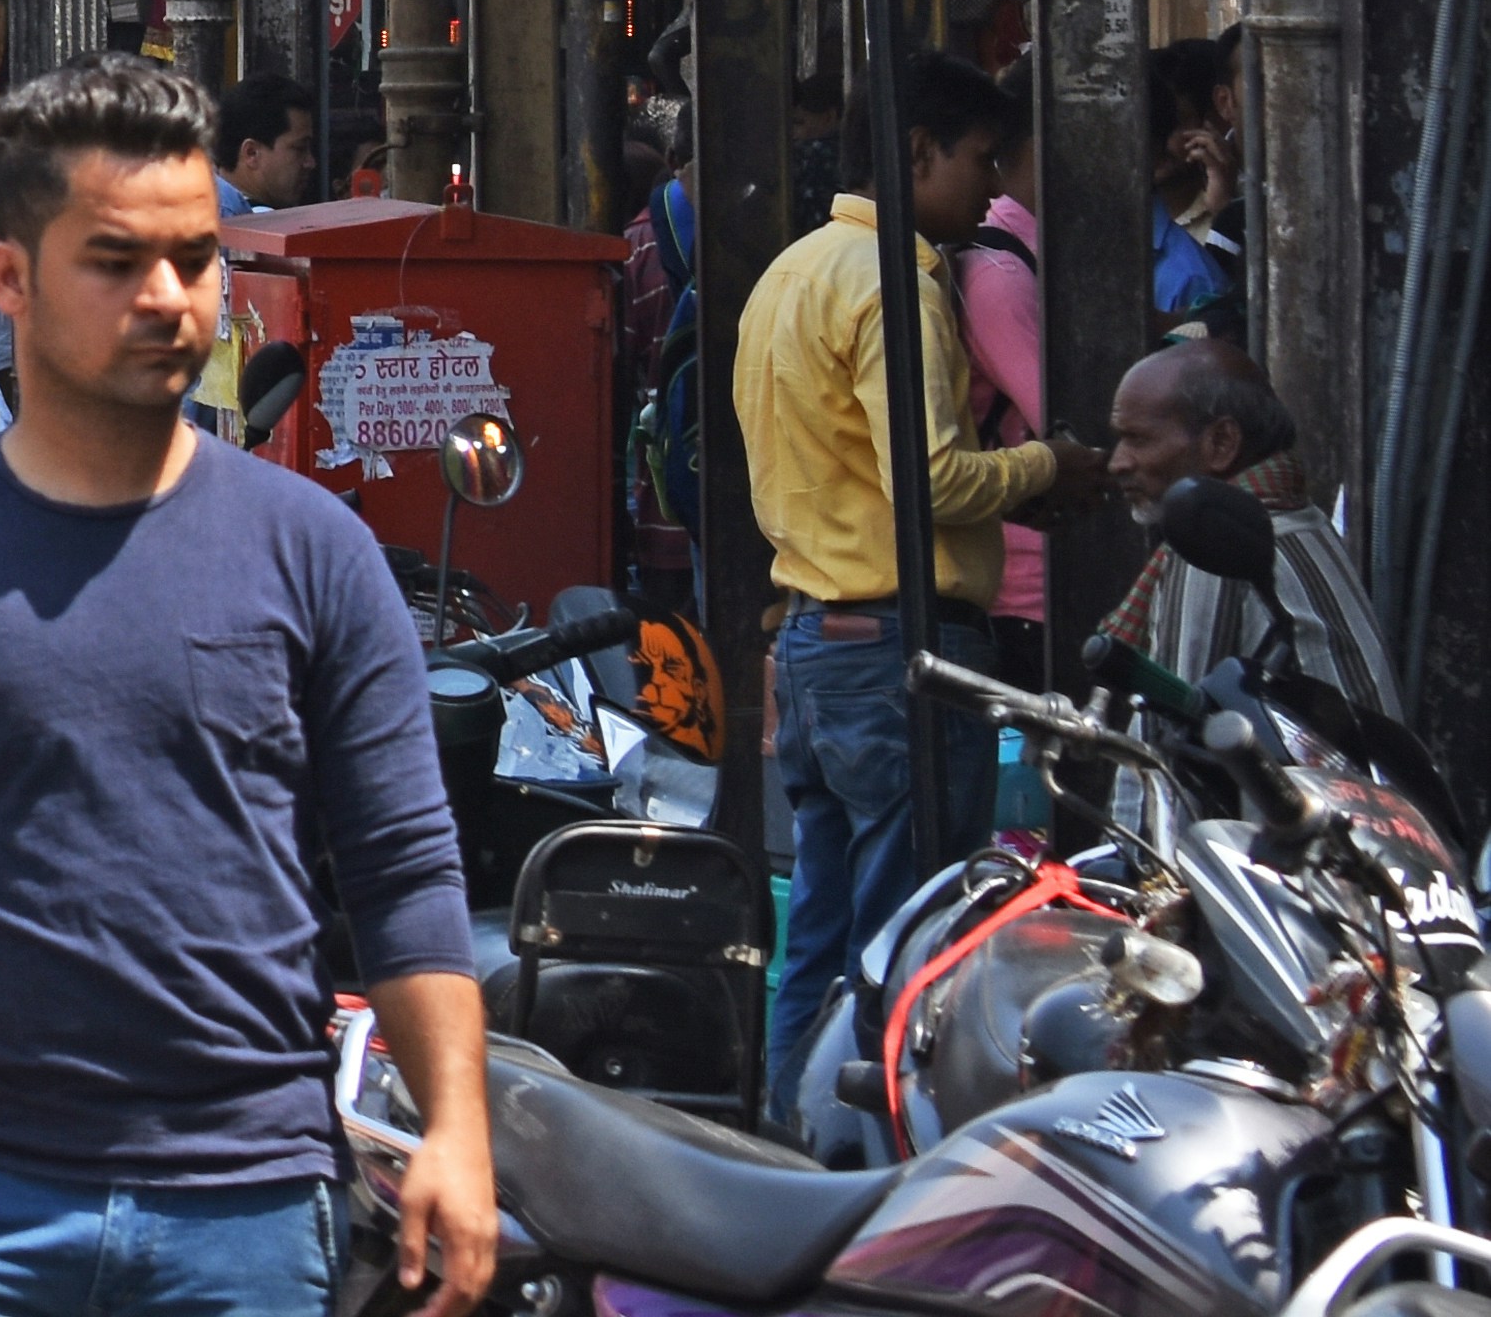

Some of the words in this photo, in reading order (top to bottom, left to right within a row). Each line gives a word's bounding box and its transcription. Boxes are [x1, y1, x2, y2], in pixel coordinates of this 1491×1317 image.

[374, 355, 421, 380] स्टार
[428, 349, 480, 381] होटल
[358, 401, 375, 416] Per
[376, 399, 396, 420] Day
